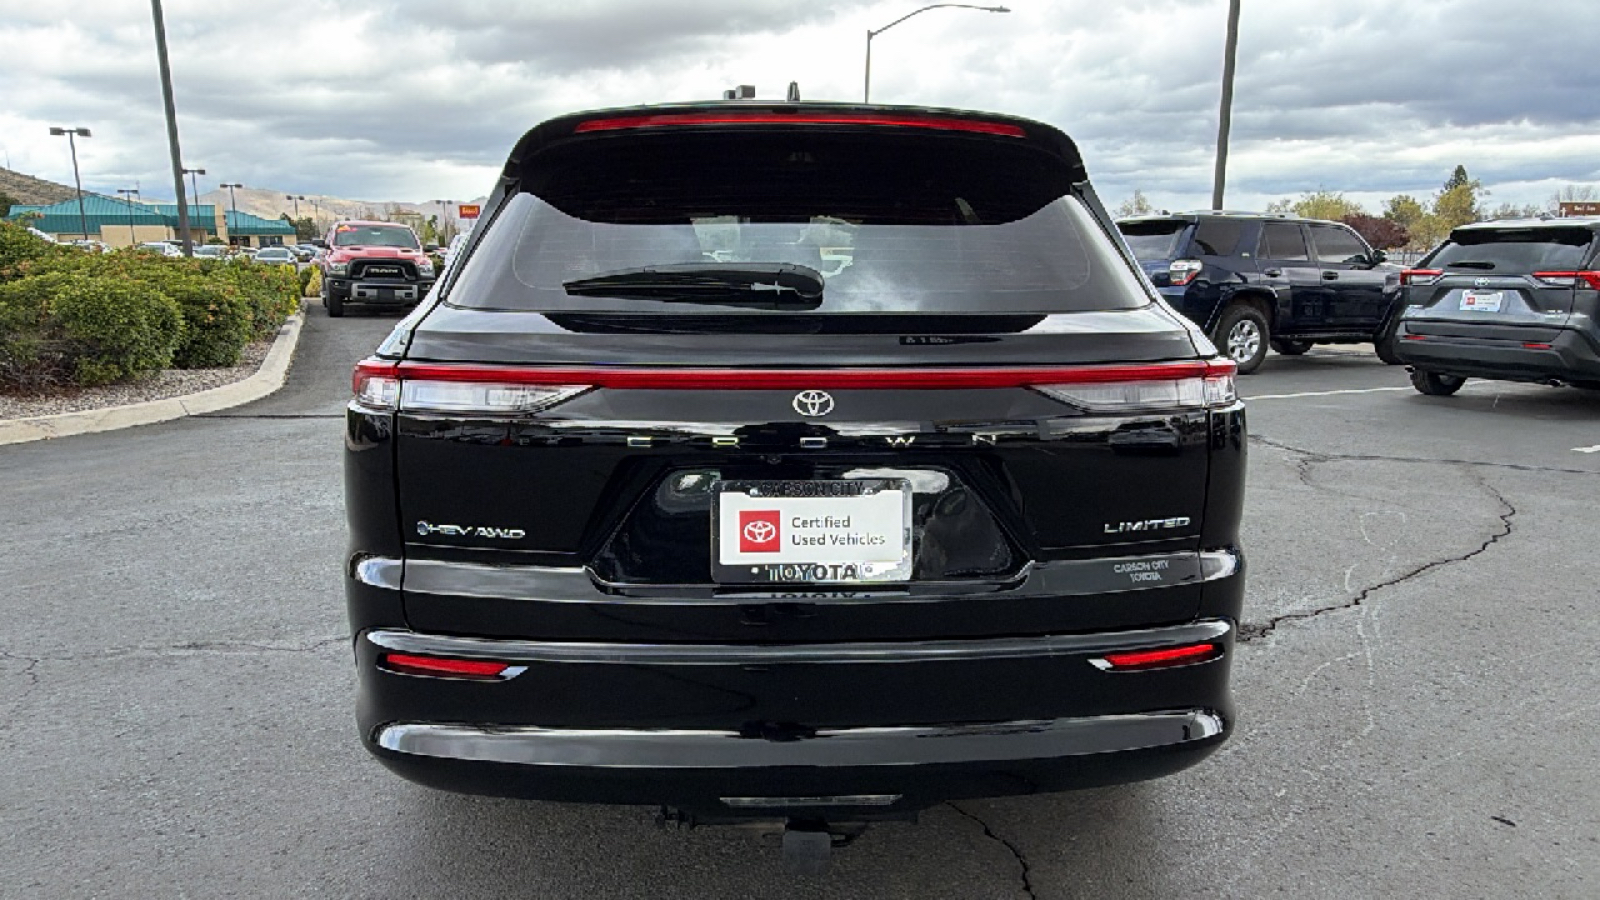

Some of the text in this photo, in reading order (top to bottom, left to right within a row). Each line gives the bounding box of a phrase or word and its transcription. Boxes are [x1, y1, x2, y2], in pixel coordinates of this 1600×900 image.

[761, 482, 864, 496] CARSON CITY
[791, 516, 851, 528] Certified
[1104, 516, 1191, 534] LIMITED
[791, 532, 886, 546] Used Vehicles
[765, 564, 859, 581] TOYOTA
[1113, 560, 1170, 573] CARSON CITY
[1130, 571, 1162, 583] TOYOTA
